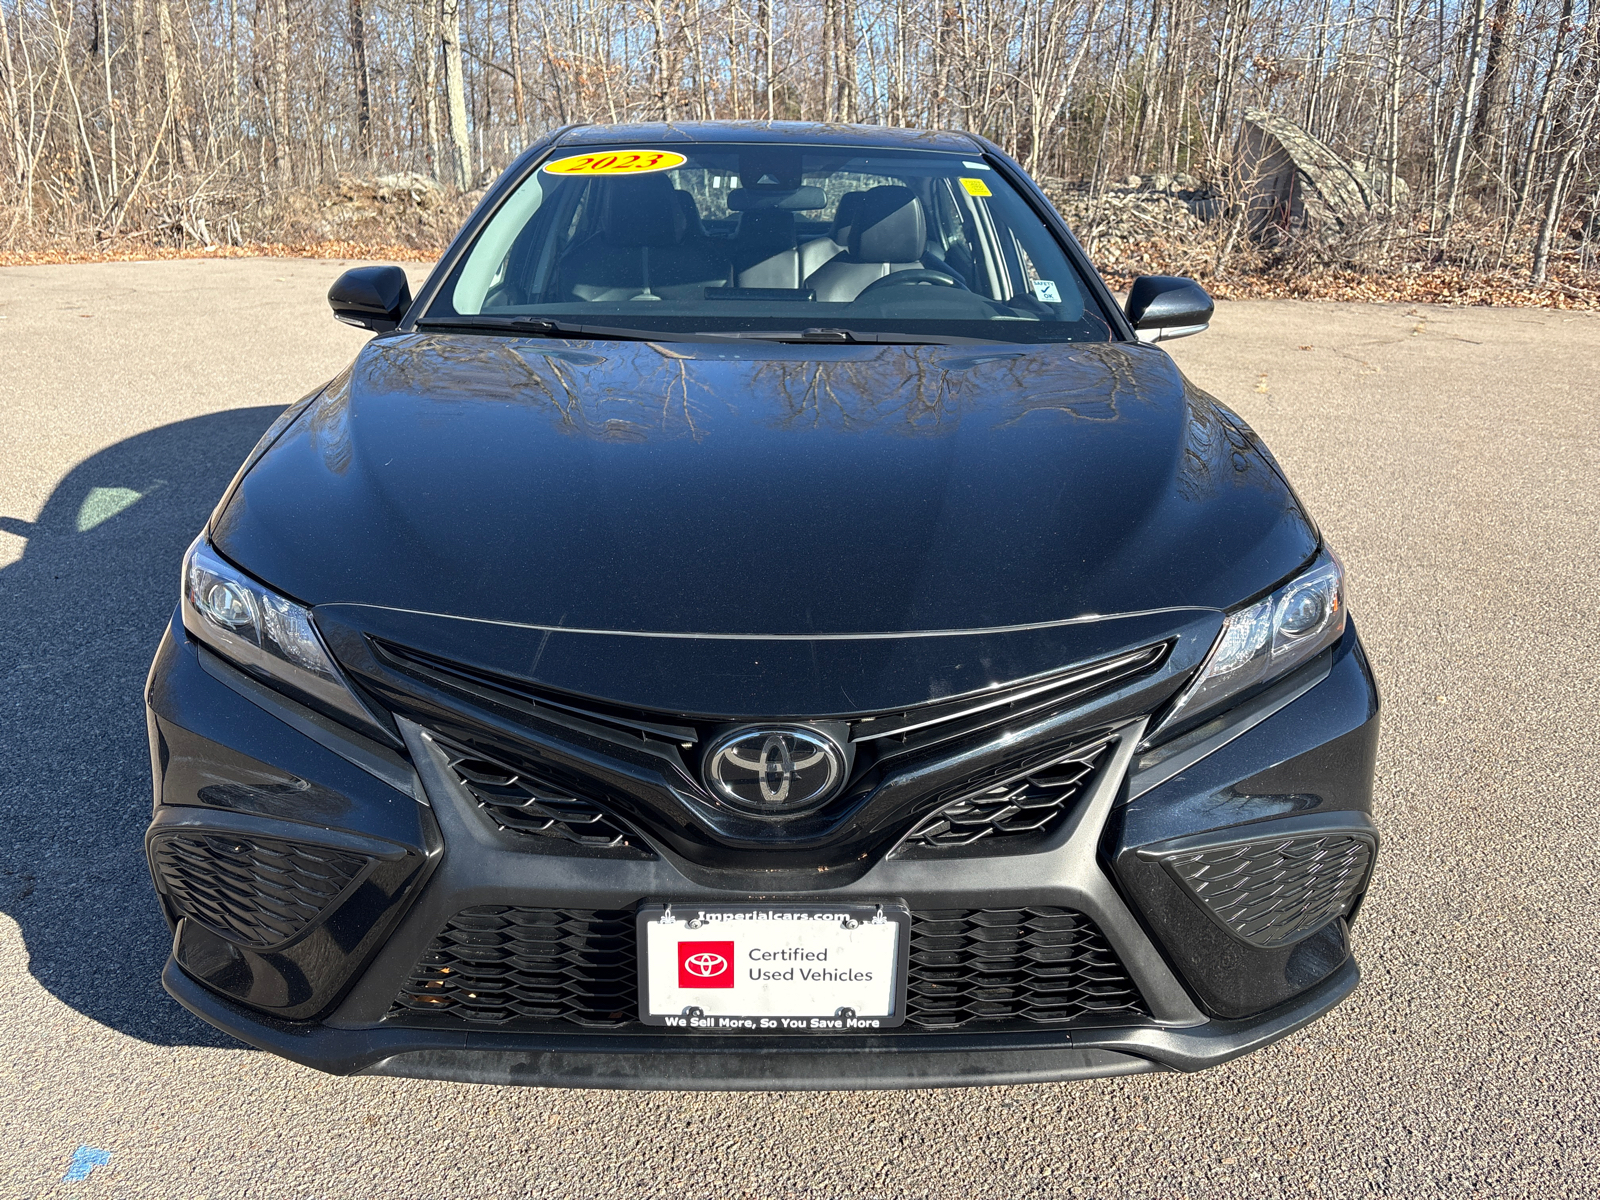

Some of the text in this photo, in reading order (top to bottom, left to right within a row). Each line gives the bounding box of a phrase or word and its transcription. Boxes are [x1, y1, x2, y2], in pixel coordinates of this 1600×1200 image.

[565, 154, 664, 172] 2023
[698, 911, 850, 922] Imperialcars.com
[748, 947, 828, 961] Certified
[749, 967, 873, 981] Used Vehicles
[665, 1016, 880, 1030] We Sell More, So You Save More
